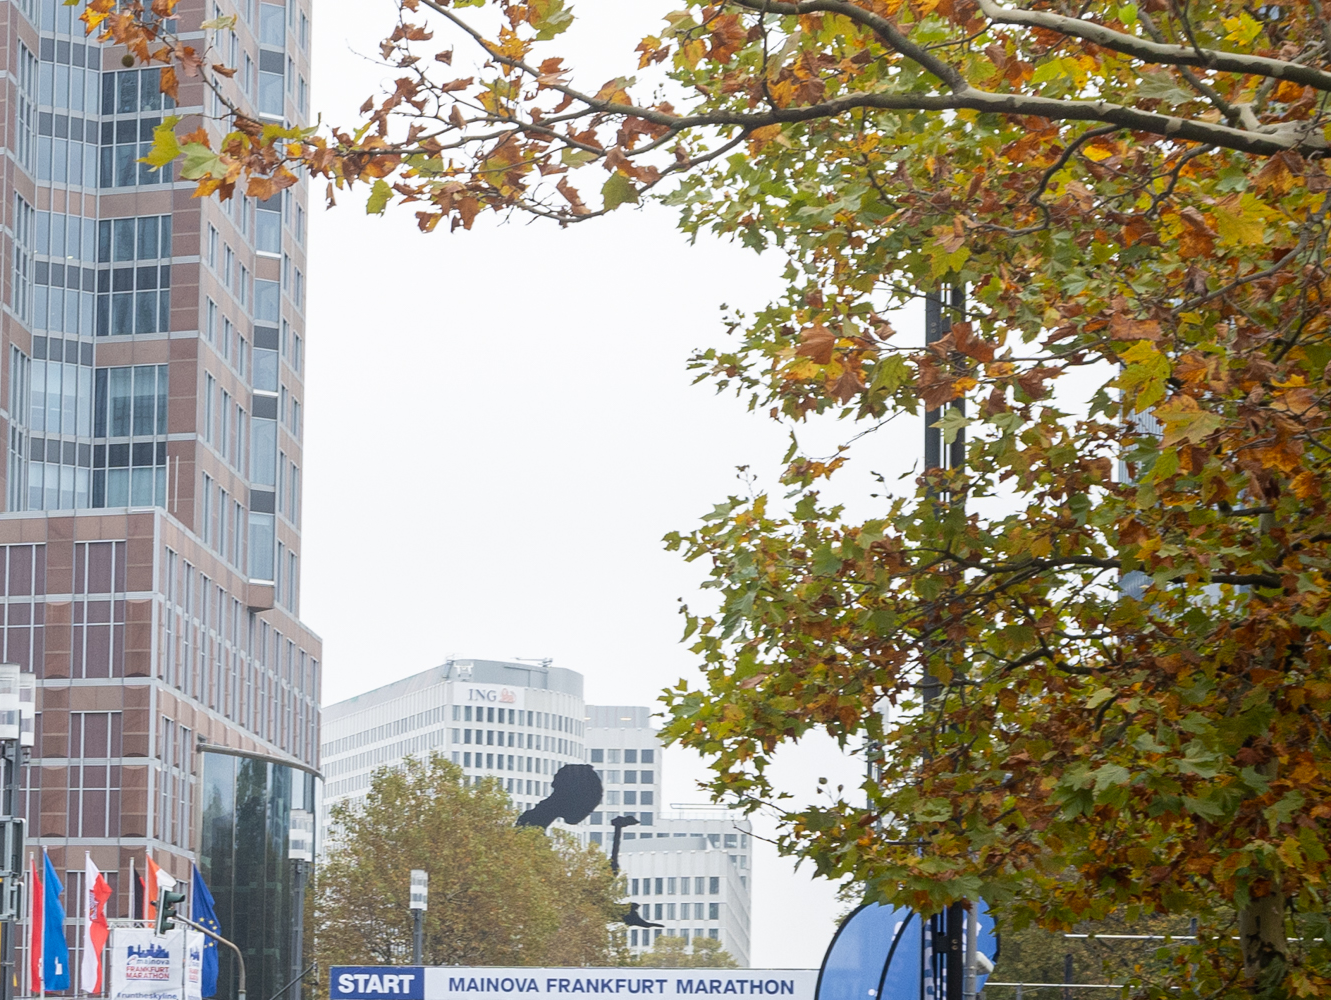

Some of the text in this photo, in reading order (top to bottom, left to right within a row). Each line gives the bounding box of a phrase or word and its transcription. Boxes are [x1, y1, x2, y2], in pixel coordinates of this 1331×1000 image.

[469, 688, 497, 702] ING
[338, 973, 794, 996] START MAINOVA FRANKFURT MARATHON
